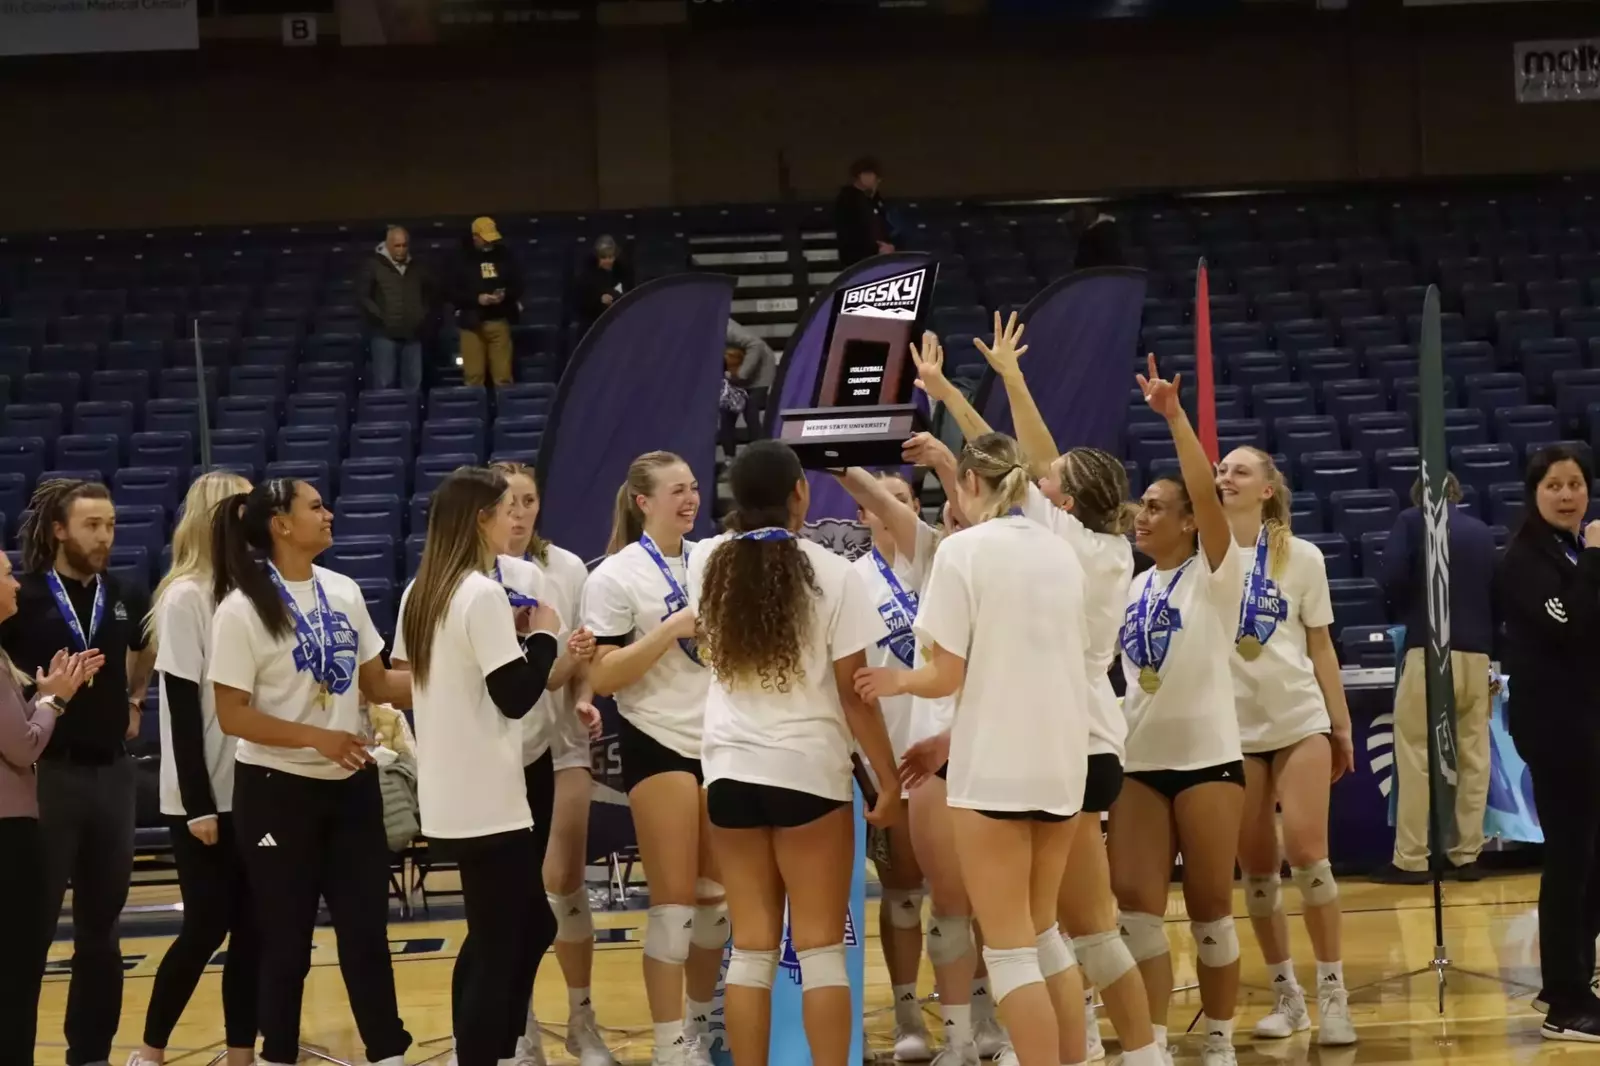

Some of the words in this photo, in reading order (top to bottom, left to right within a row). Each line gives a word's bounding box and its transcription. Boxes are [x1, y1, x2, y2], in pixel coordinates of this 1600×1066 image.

[291, 20, 309, 39] B
[850, 365, 884, 373] VOLLEYBALL
[847, 376, 881, 384] CHAMPIONS
[852, 388, 871, 396] 2023
[849, 421, 887, 429] UNIVERSITY
